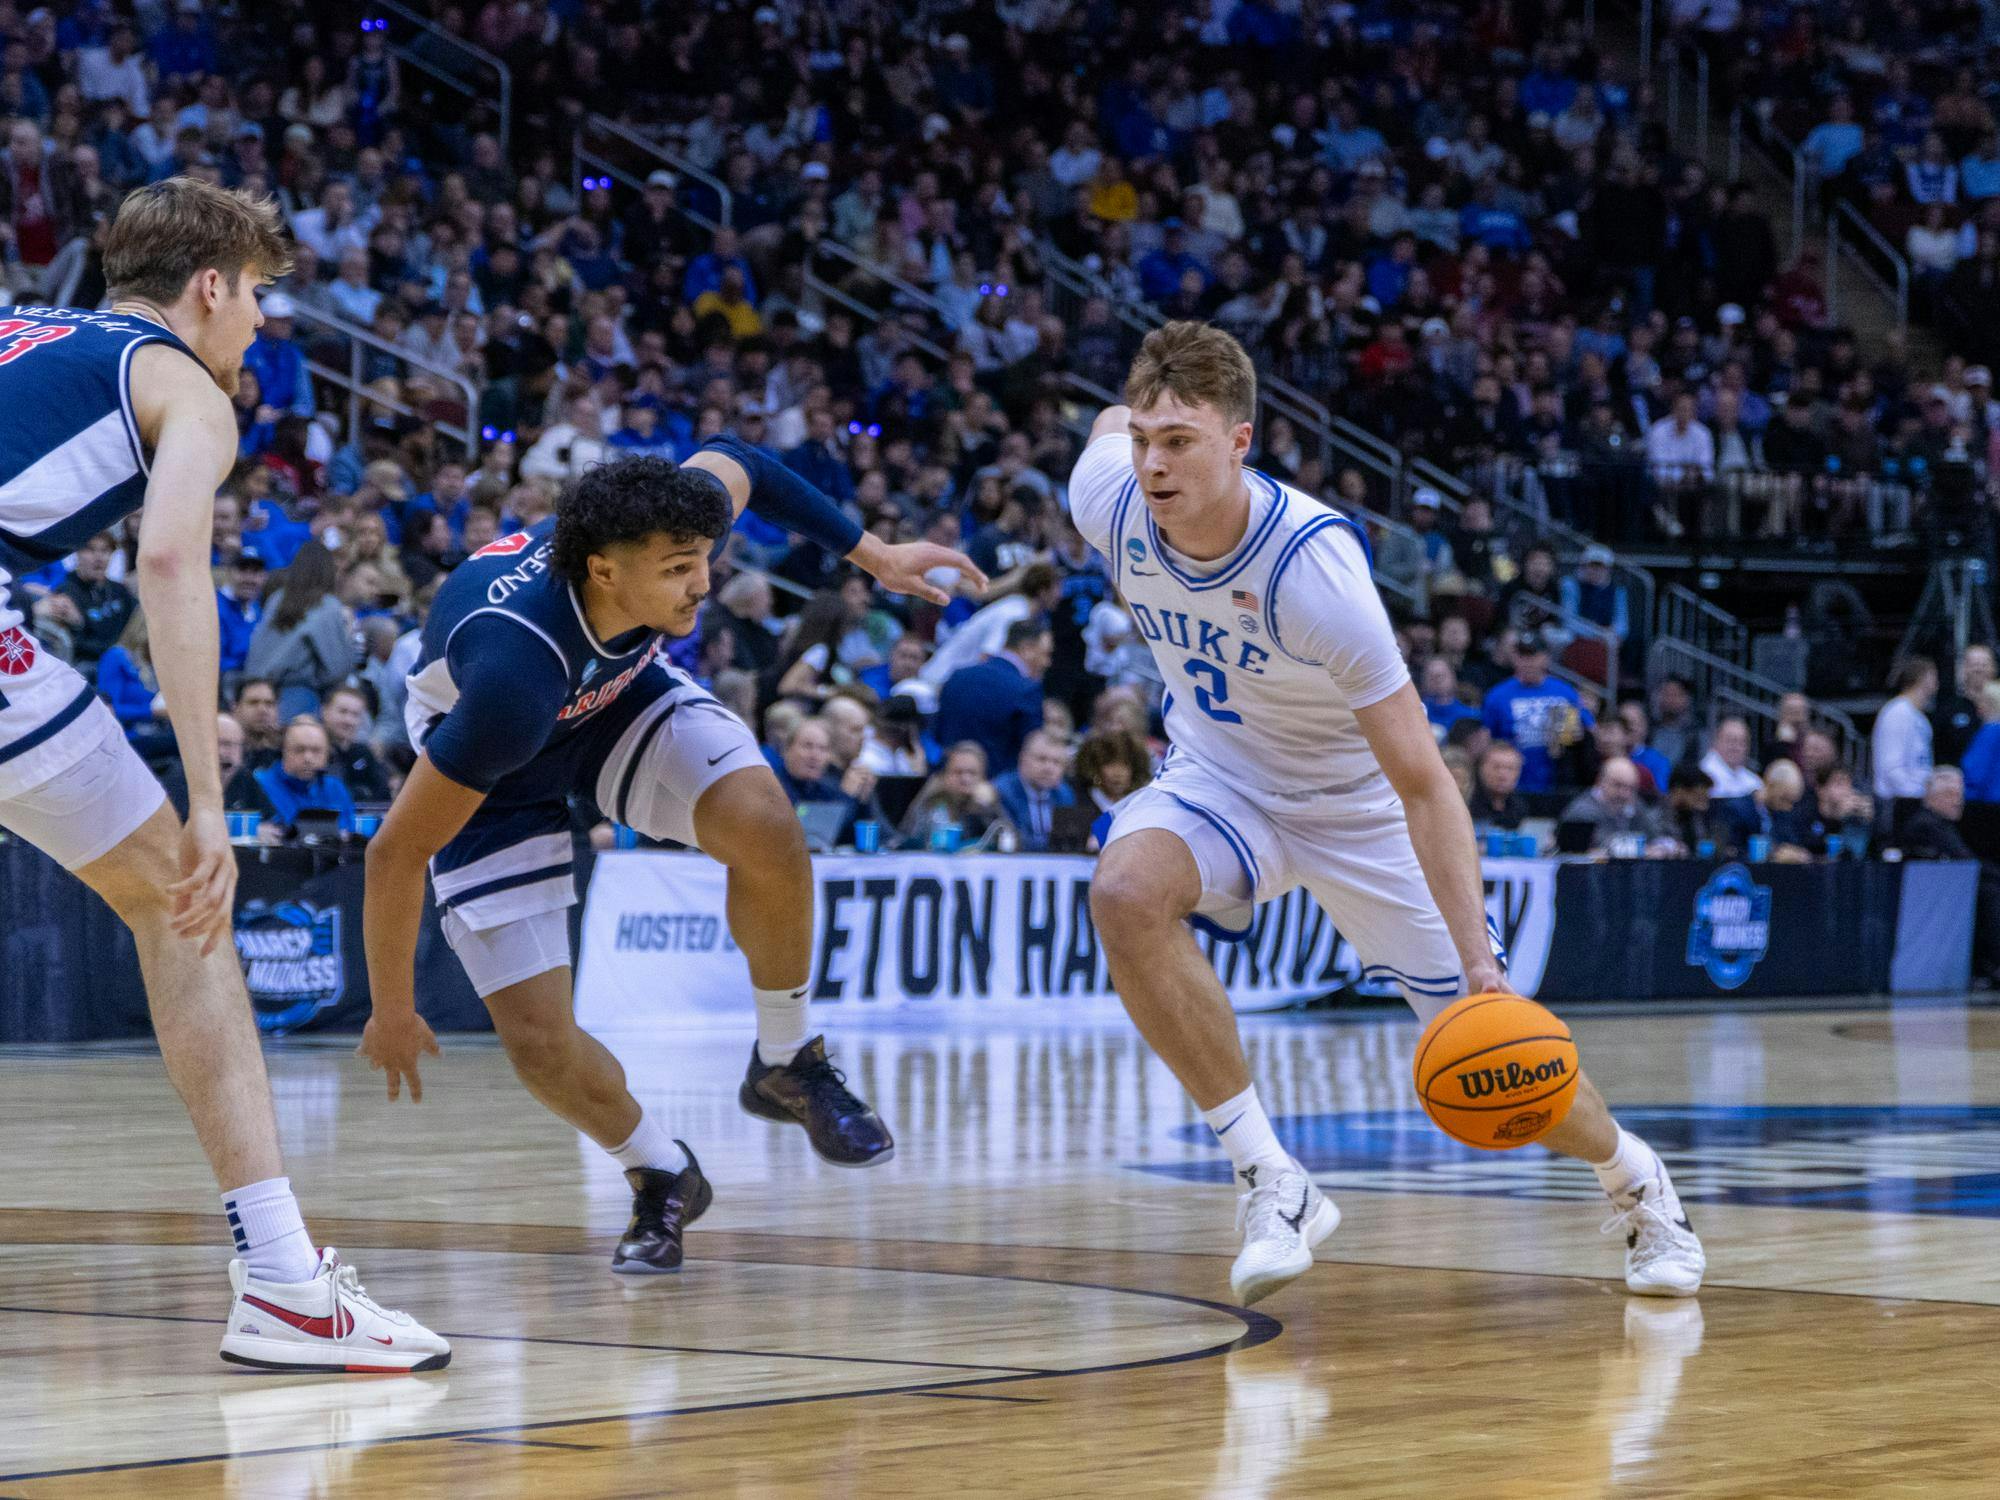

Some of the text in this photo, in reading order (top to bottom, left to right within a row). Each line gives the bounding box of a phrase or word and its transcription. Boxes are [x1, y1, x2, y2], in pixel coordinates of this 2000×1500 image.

[487, 541, 554, 604] SEND
[1130, 602, 1269, 675] DUKE
[1183, 658, 1243, 725] 2
[616, 914, 719, 952] HOSTED
[811, 877, 995, 999] ETON
[1457, 1057, 1566, 1099] Wilson
